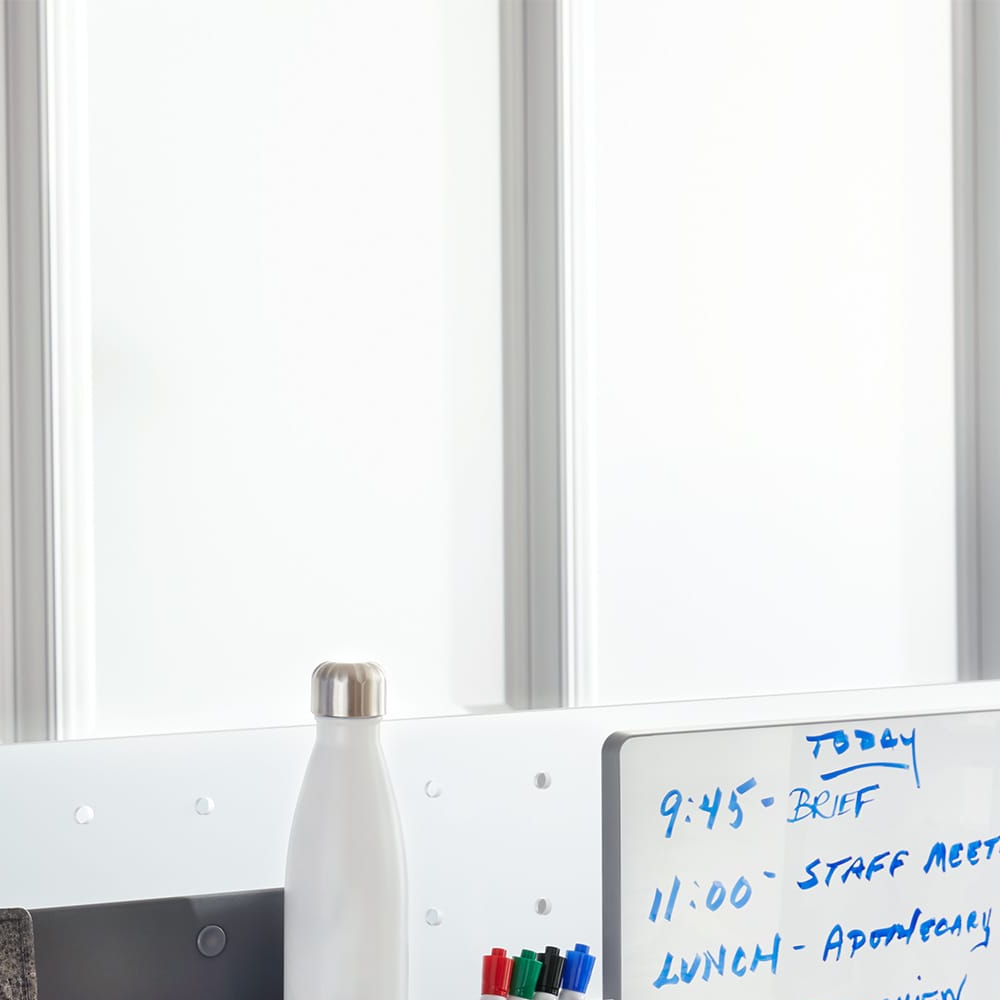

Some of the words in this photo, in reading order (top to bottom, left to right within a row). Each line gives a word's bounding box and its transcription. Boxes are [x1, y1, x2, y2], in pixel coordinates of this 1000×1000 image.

[806, 728, 921, 788] TODAY
[787, 784, 881, 823] BRIEF
[797, 850, 910, 890] STAFF
